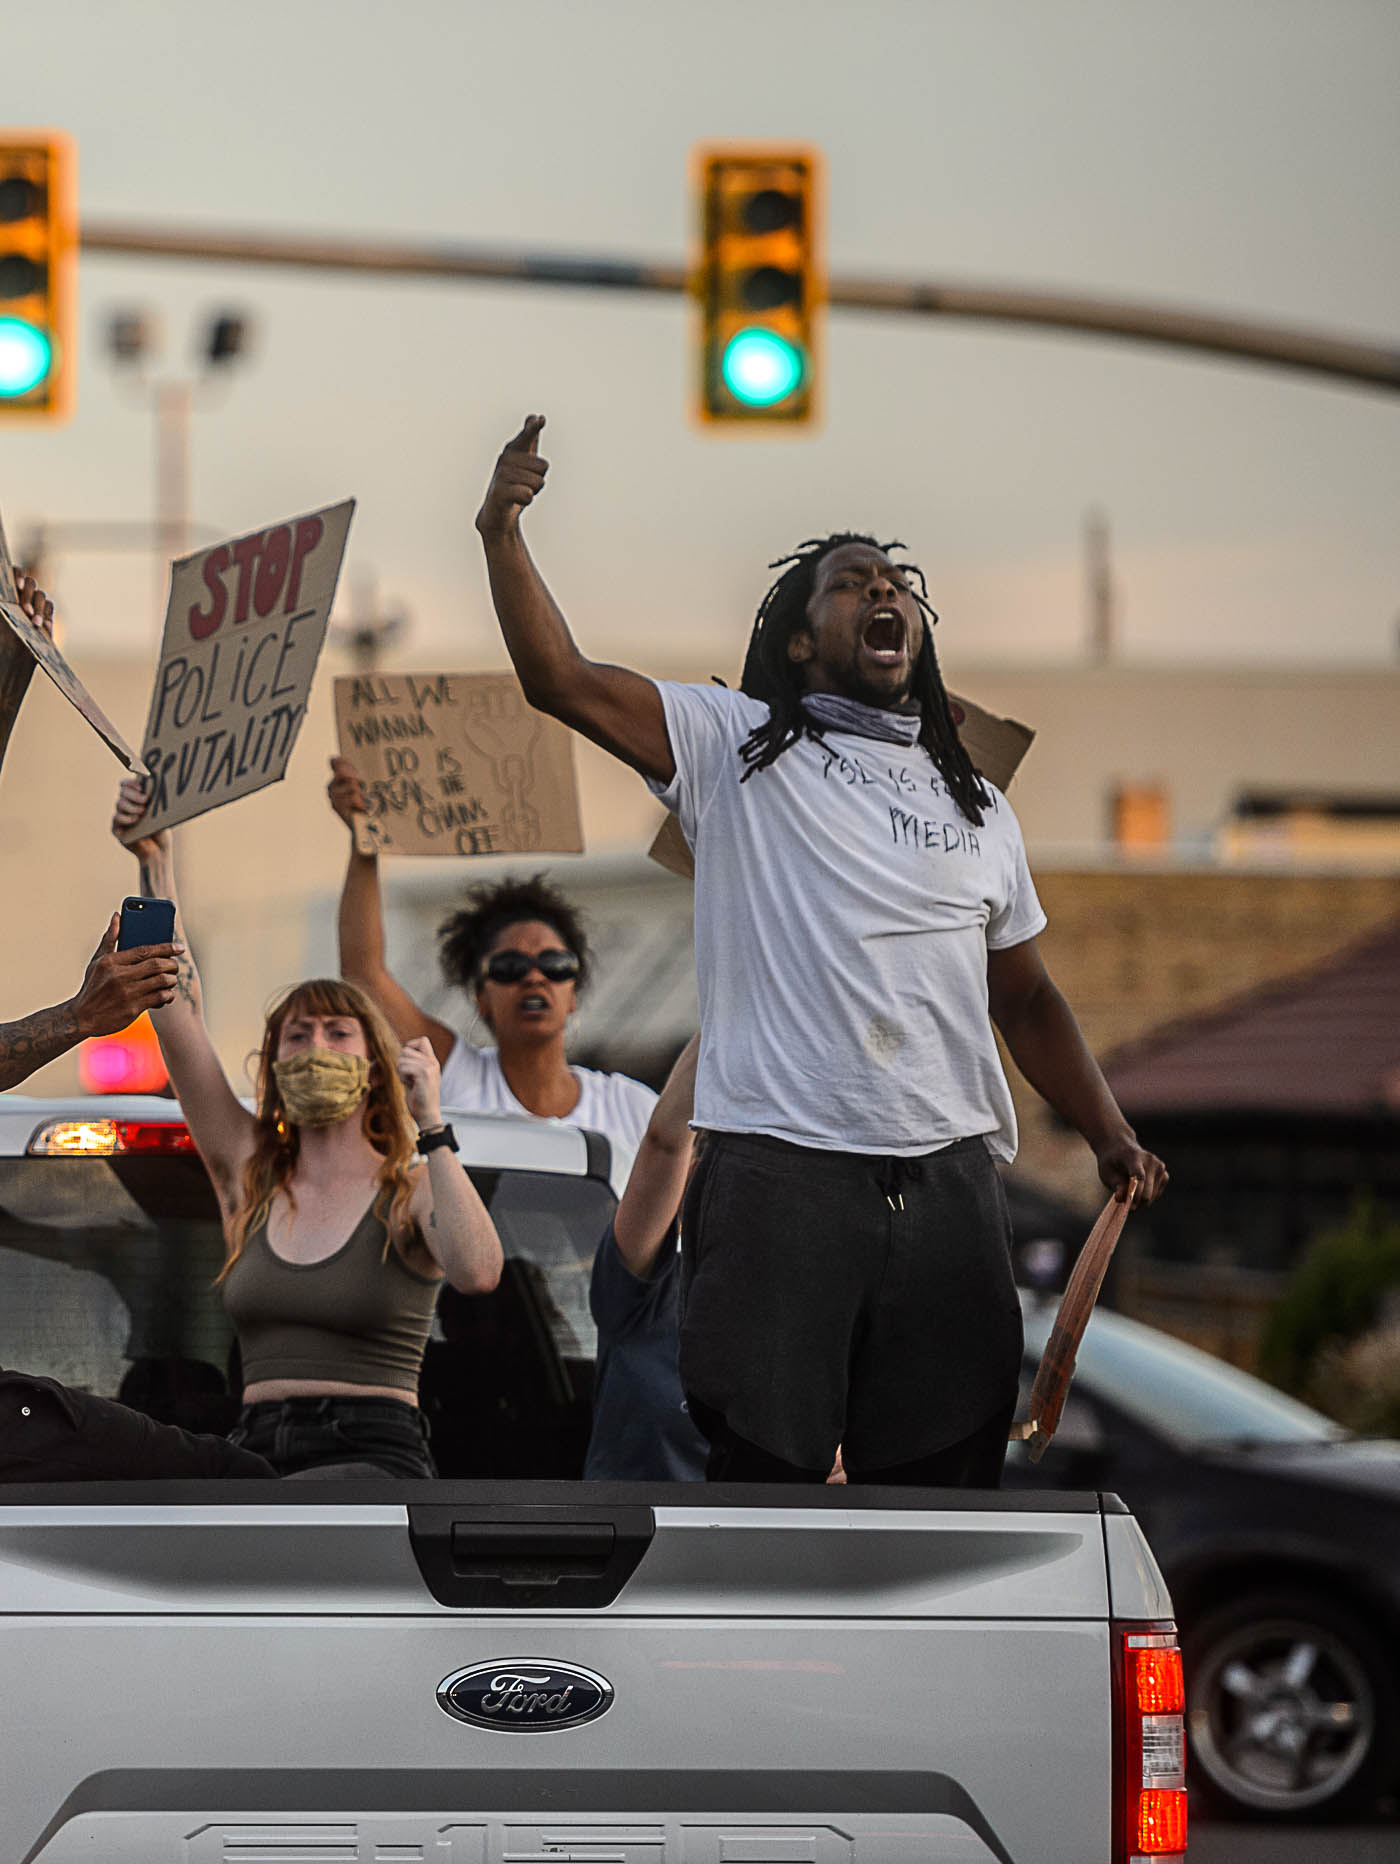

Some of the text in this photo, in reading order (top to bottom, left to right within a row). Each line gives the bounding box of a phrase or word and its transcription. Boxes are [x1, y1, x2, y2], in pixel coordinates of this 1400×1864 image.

[189, 517, 323, 640] STOP
[352, 677, 399, 710] ALL
[348, 713, 434, 747] WANNA
[385, 746, 419, 777] DO
[888, 805, 981, 858] MEDIA
[481, 1674, 573, 1714] Ford
